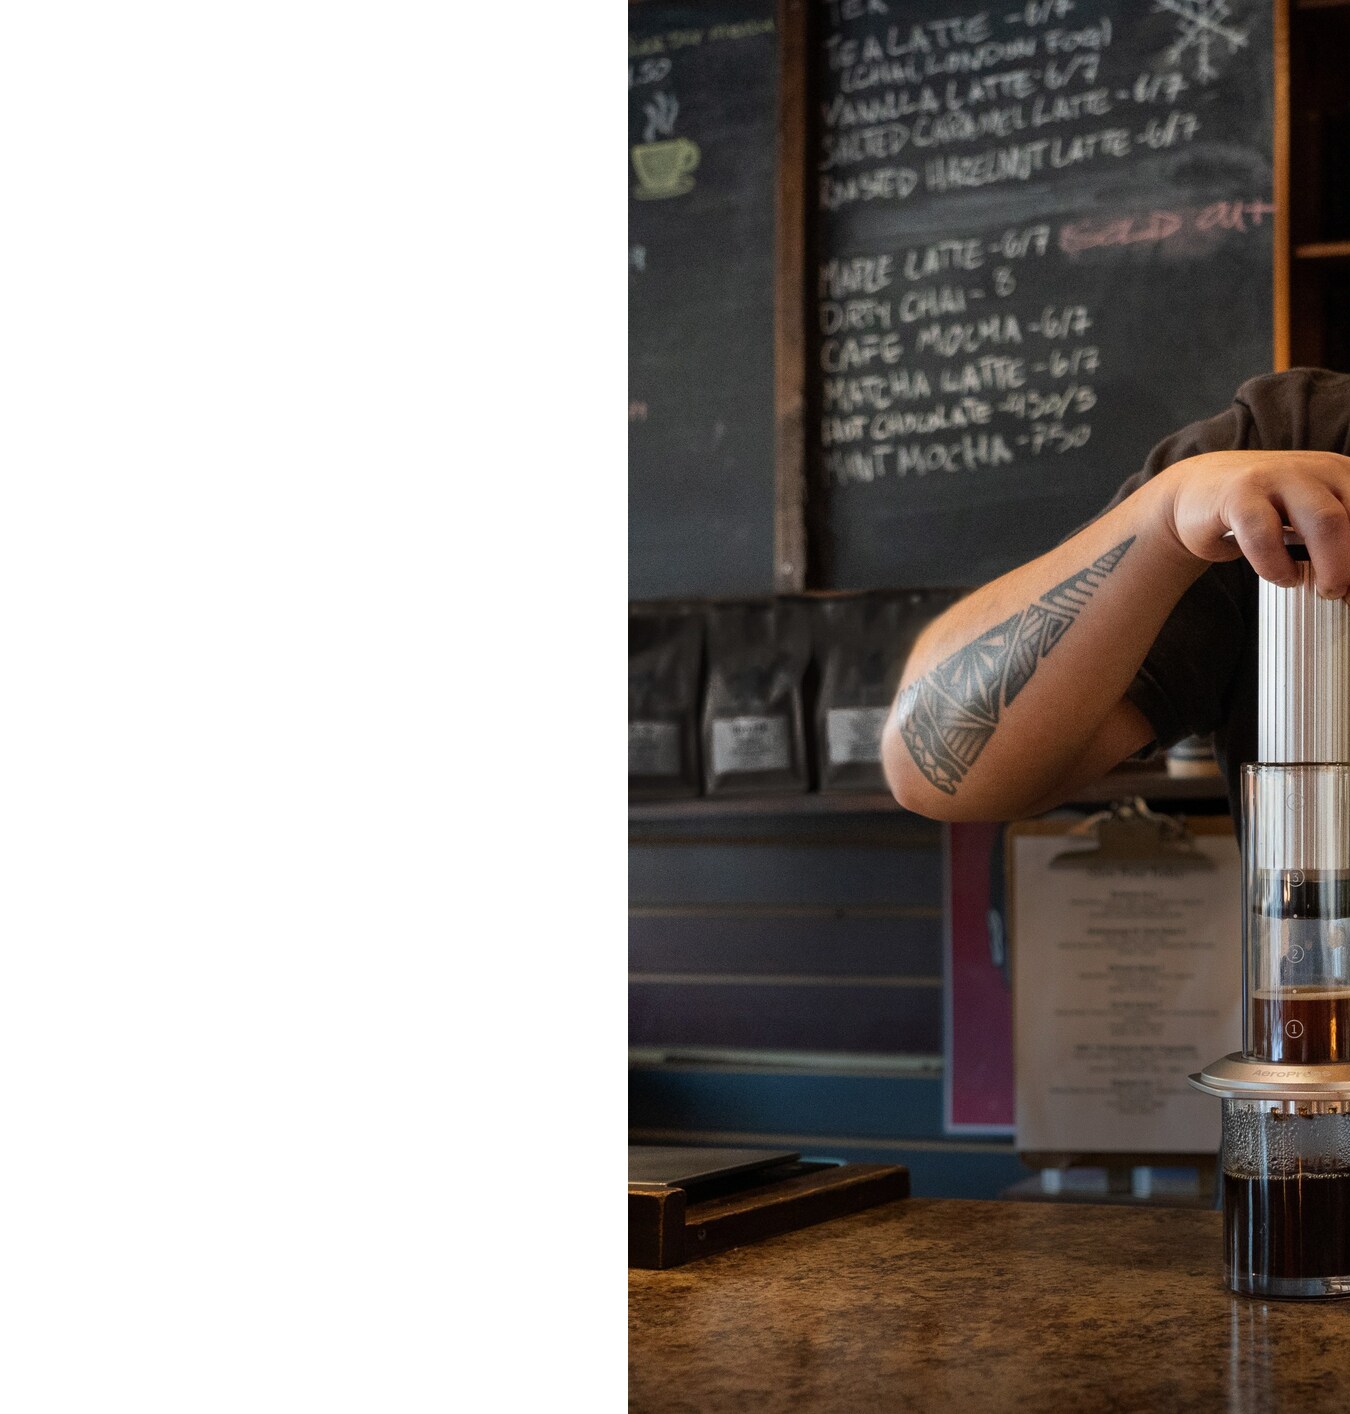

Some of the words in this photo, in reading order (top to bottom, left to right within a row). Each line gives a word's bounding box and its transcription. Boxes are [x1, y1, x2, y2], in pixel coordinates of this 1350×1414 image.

[886, 11, 991, 57] LATTE
[822, 84, 939, 128] VANILLA
[945, 68, 1037, 110] LATTE
[1031, 87, 1112, 126] LATTE
[1050, 127, 1132, 168] LATTE
[904, 238, 985, 281] LATTE
[819, 332, 904, 374] CAFE
[915, 313, 1023, 358] MOCHA
[822, 369, 931, 412] MATCHA
[940, 355, 1027, 394] LATTE
[870, 397, 993, 441] CHOCOLATE
[897, 432, 1013, 477] MOCHA
